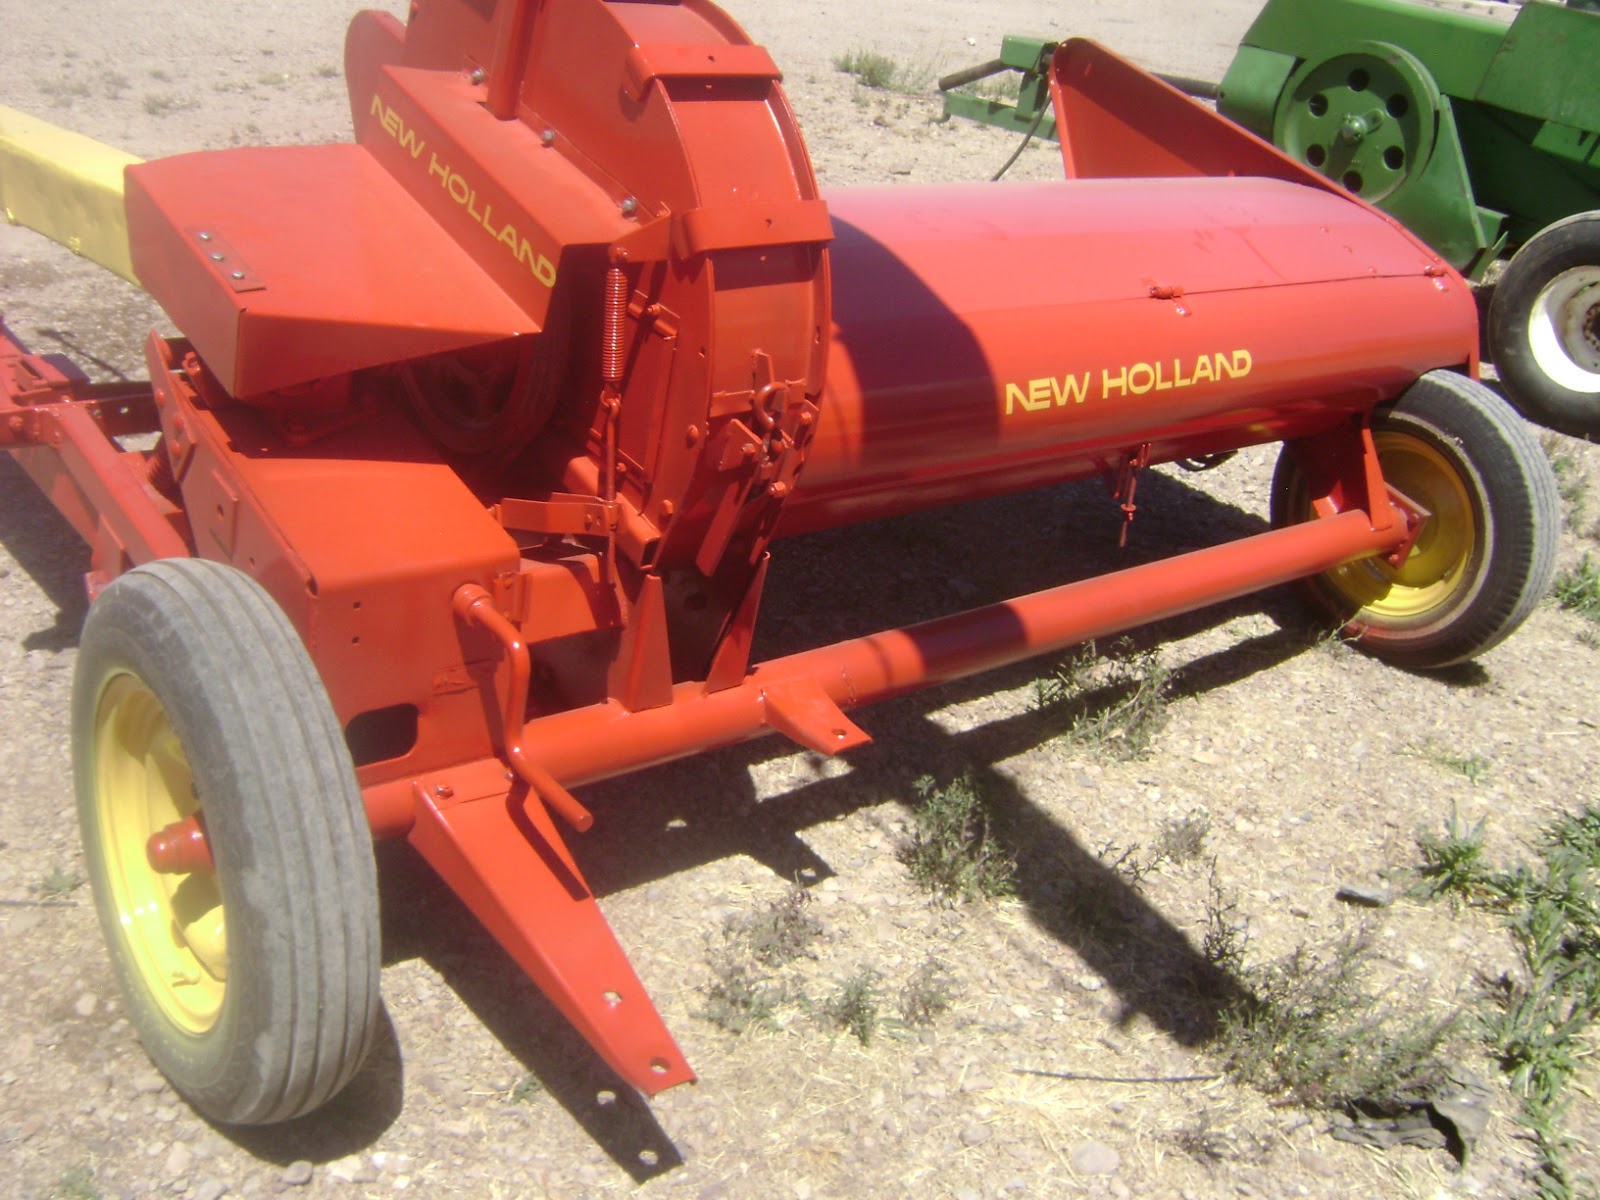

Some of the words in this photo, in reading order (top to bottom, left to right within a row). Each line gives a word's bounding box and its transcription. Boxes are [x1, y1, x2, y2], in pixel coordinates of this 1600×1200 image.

[370, 93, 425, 159] NEW
[428, 152, 557, 288] HOLLAND
[1005, 371, 1090, 415] NEW
[1102, 349, 1252, 399] HOLLAND
